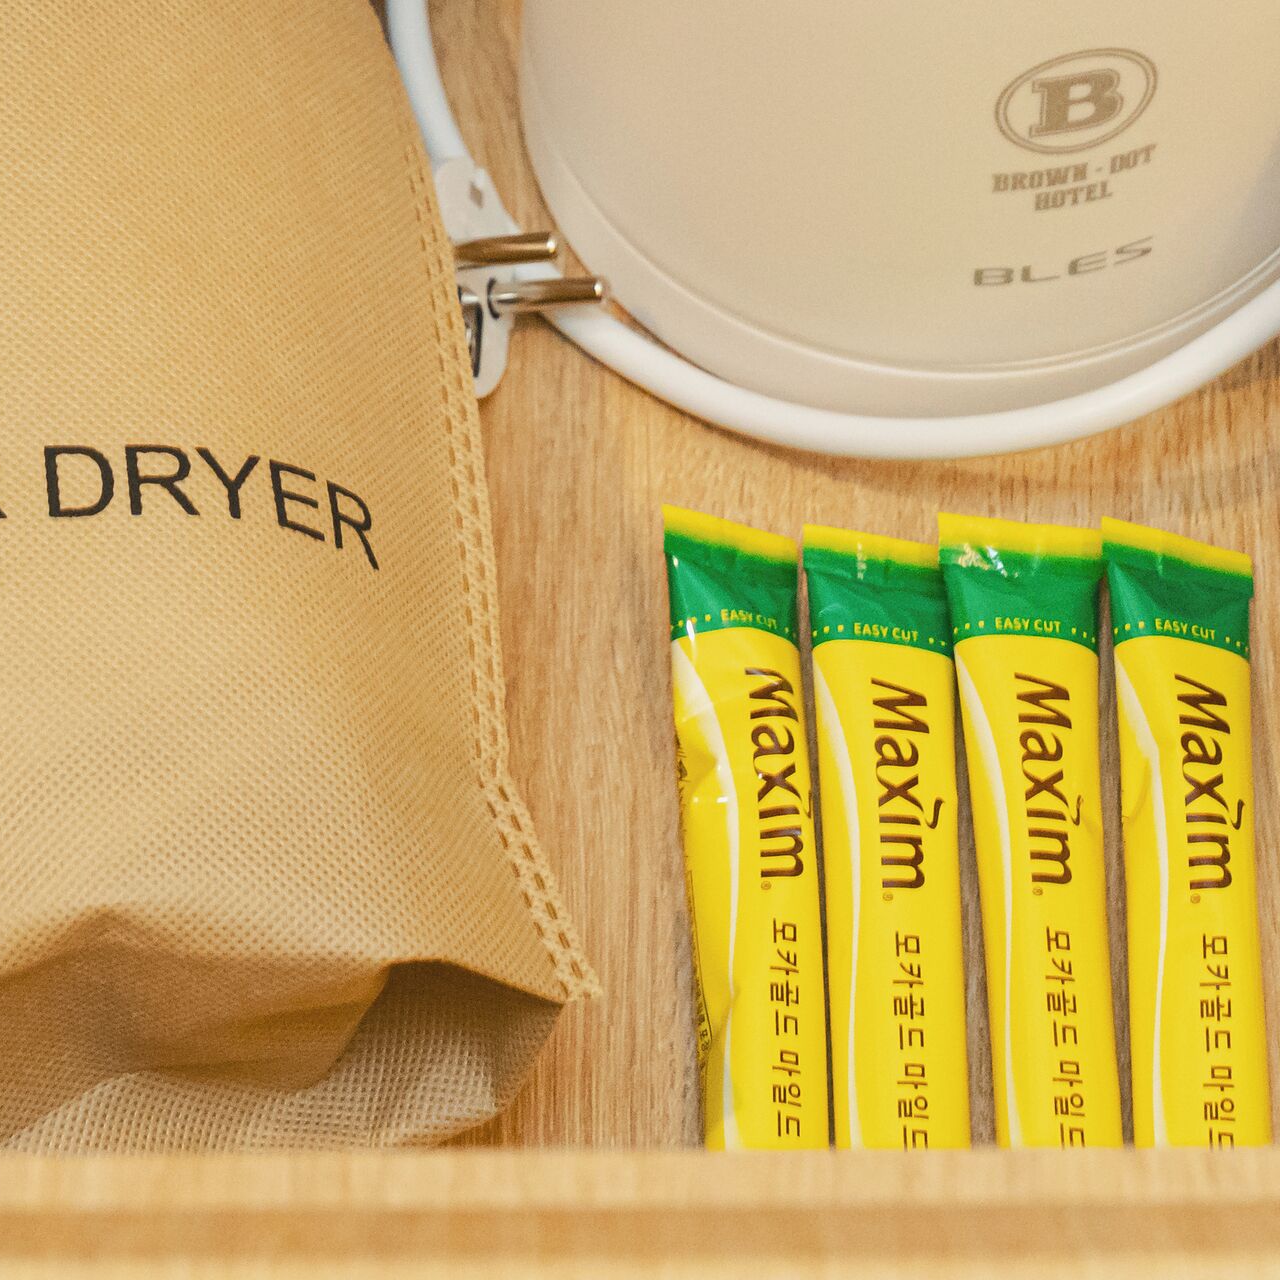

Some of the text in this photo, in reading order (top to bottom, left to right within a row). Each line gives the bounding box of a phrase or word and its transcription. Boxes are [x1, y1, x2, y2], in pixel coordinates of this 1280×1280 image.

[991, 162, 1089, 194] BROWN
[1109, 143, 1157, 176] DOT
[1028, 67, 1124, 138] B
[972, 234, 1154, 288] BLES
[1033, 180, 1114, 212] HOTEL
[43, 443, 380, 572] DRYER
[853, 622, 919, 642] EASY CUT
[994, 616, 1061, 634] EASY CUT
[1154, 618, 1216, 641] EASY CUT
[744, 666, 812, 878] Maxim
[870, 677, 946, 890] Maxim
[1013, 671, 1084, 885] Maxim
[1174, 673, 1246, 891] Maxim
[769, 917, 802, 1138] 모카골드 마일드
[892, 930, 930, 1153] 모카골드 마일드
[1045, 925, 1086, 1148] 모카골드 마일드
[1199, 933, 1236, 1151] 모카골드 마일드
